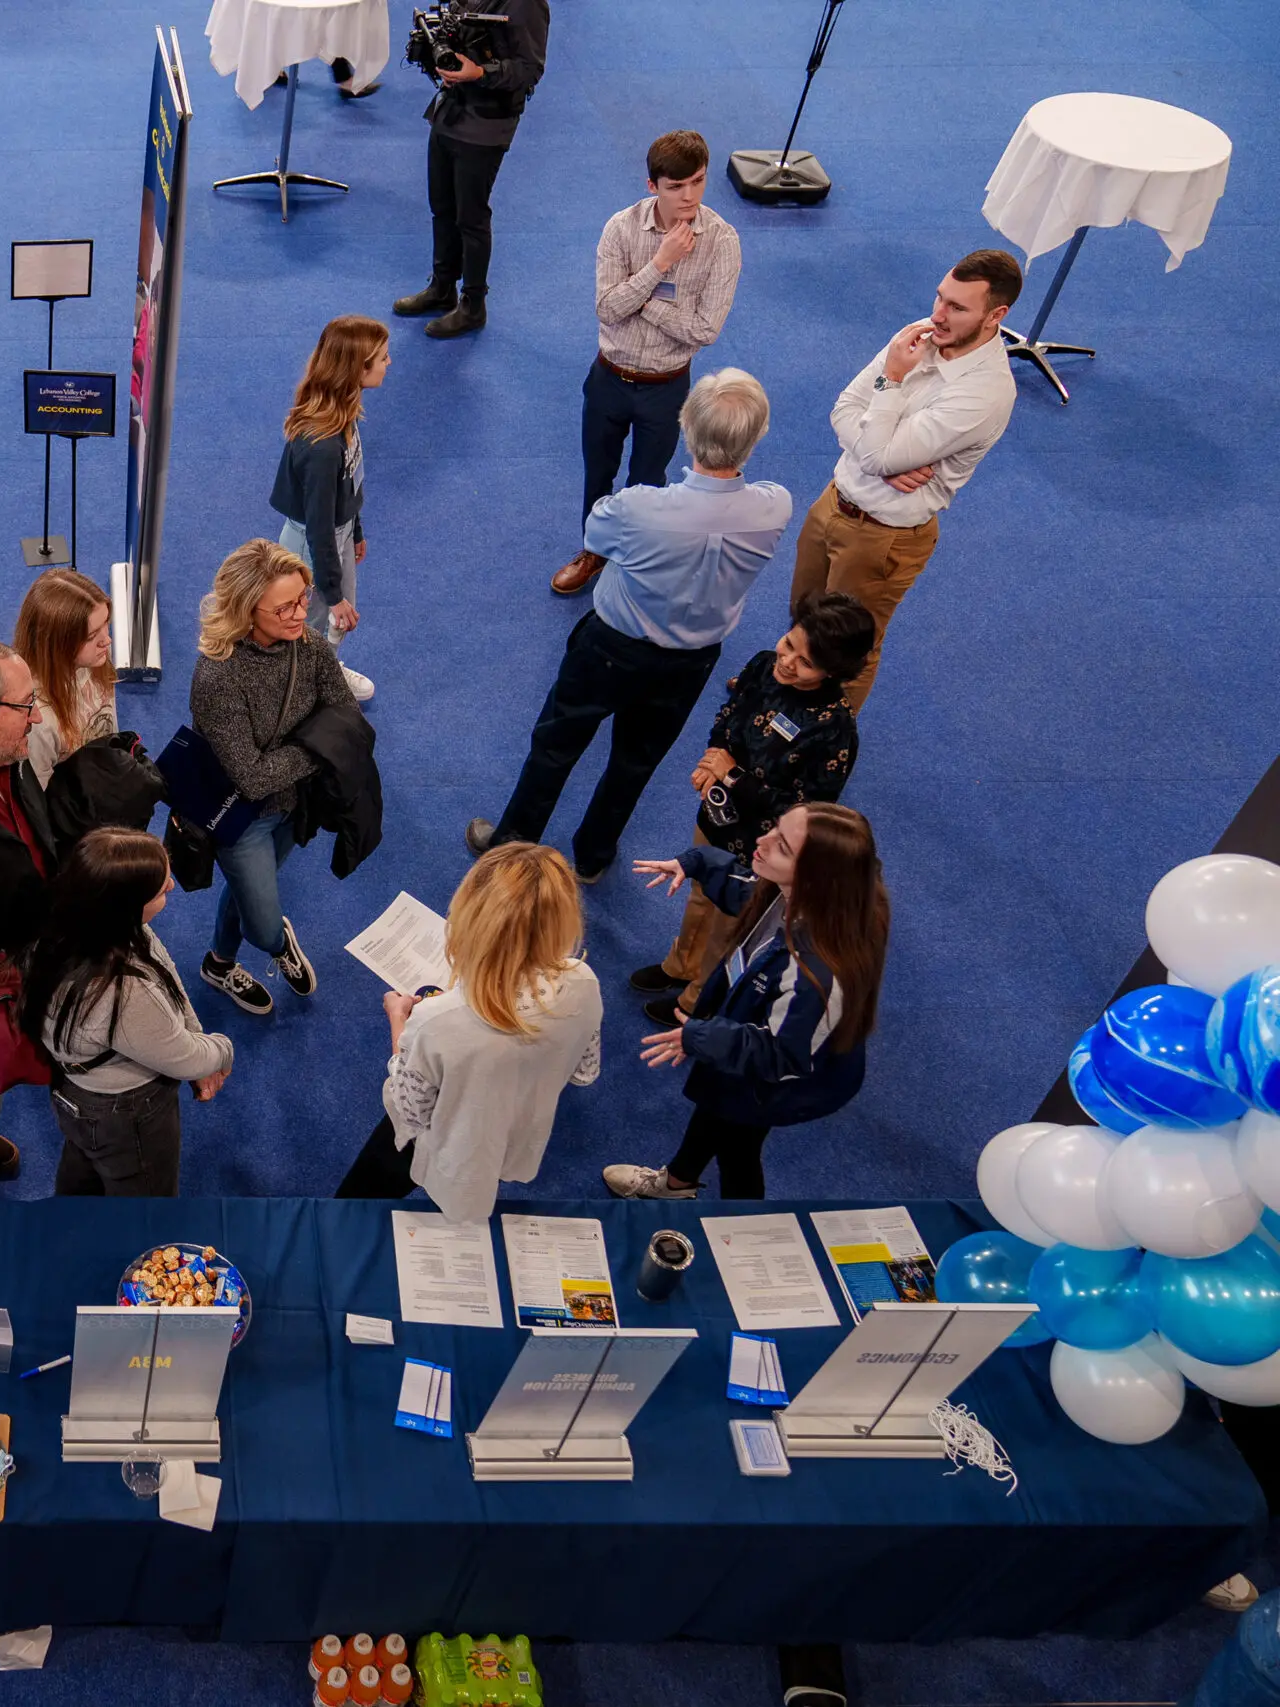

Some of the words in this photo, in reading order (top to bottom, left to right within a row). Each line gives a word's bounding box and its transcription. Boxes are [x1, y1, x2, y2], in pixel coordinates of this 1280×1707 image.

[80, 389, 101, 397] College
[37, 406, 103, 414] ACCOUNTING
[206, 807, 228, 831] Lebanon
[222, 792, 240, 809] Valley
